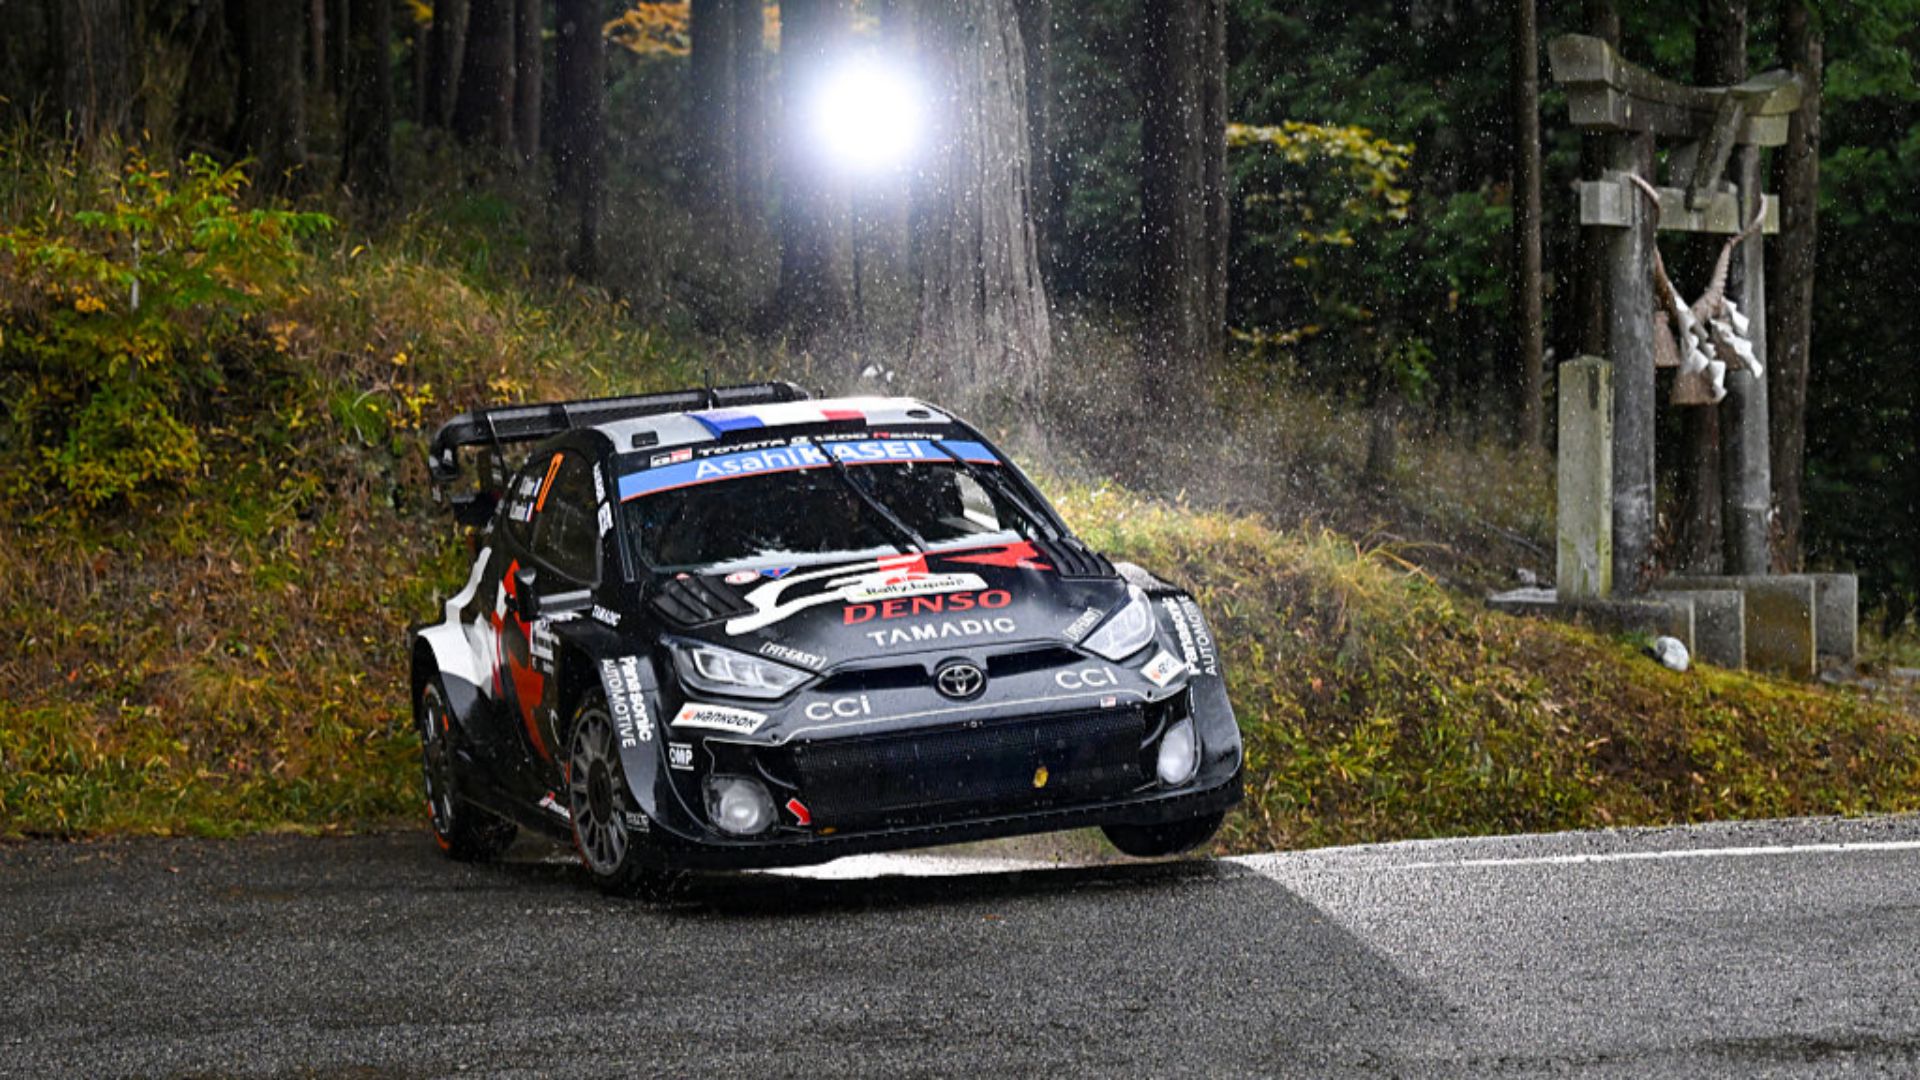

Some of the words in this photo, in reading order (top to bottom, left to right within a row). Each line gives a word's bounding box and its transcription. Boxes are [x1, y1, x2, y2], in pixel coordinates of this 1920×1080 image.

[699, 439, 786, 457] TOYOTA
[843, 589, 1012, 625] DENSO
[866, 617, 1016, 647] TAMADIC
[1161, 597, 1201, 675] Panasonic
[601, 658, 637, 749] AUTOMOTIVE
[618, 655, 655, 742] Panasonic
